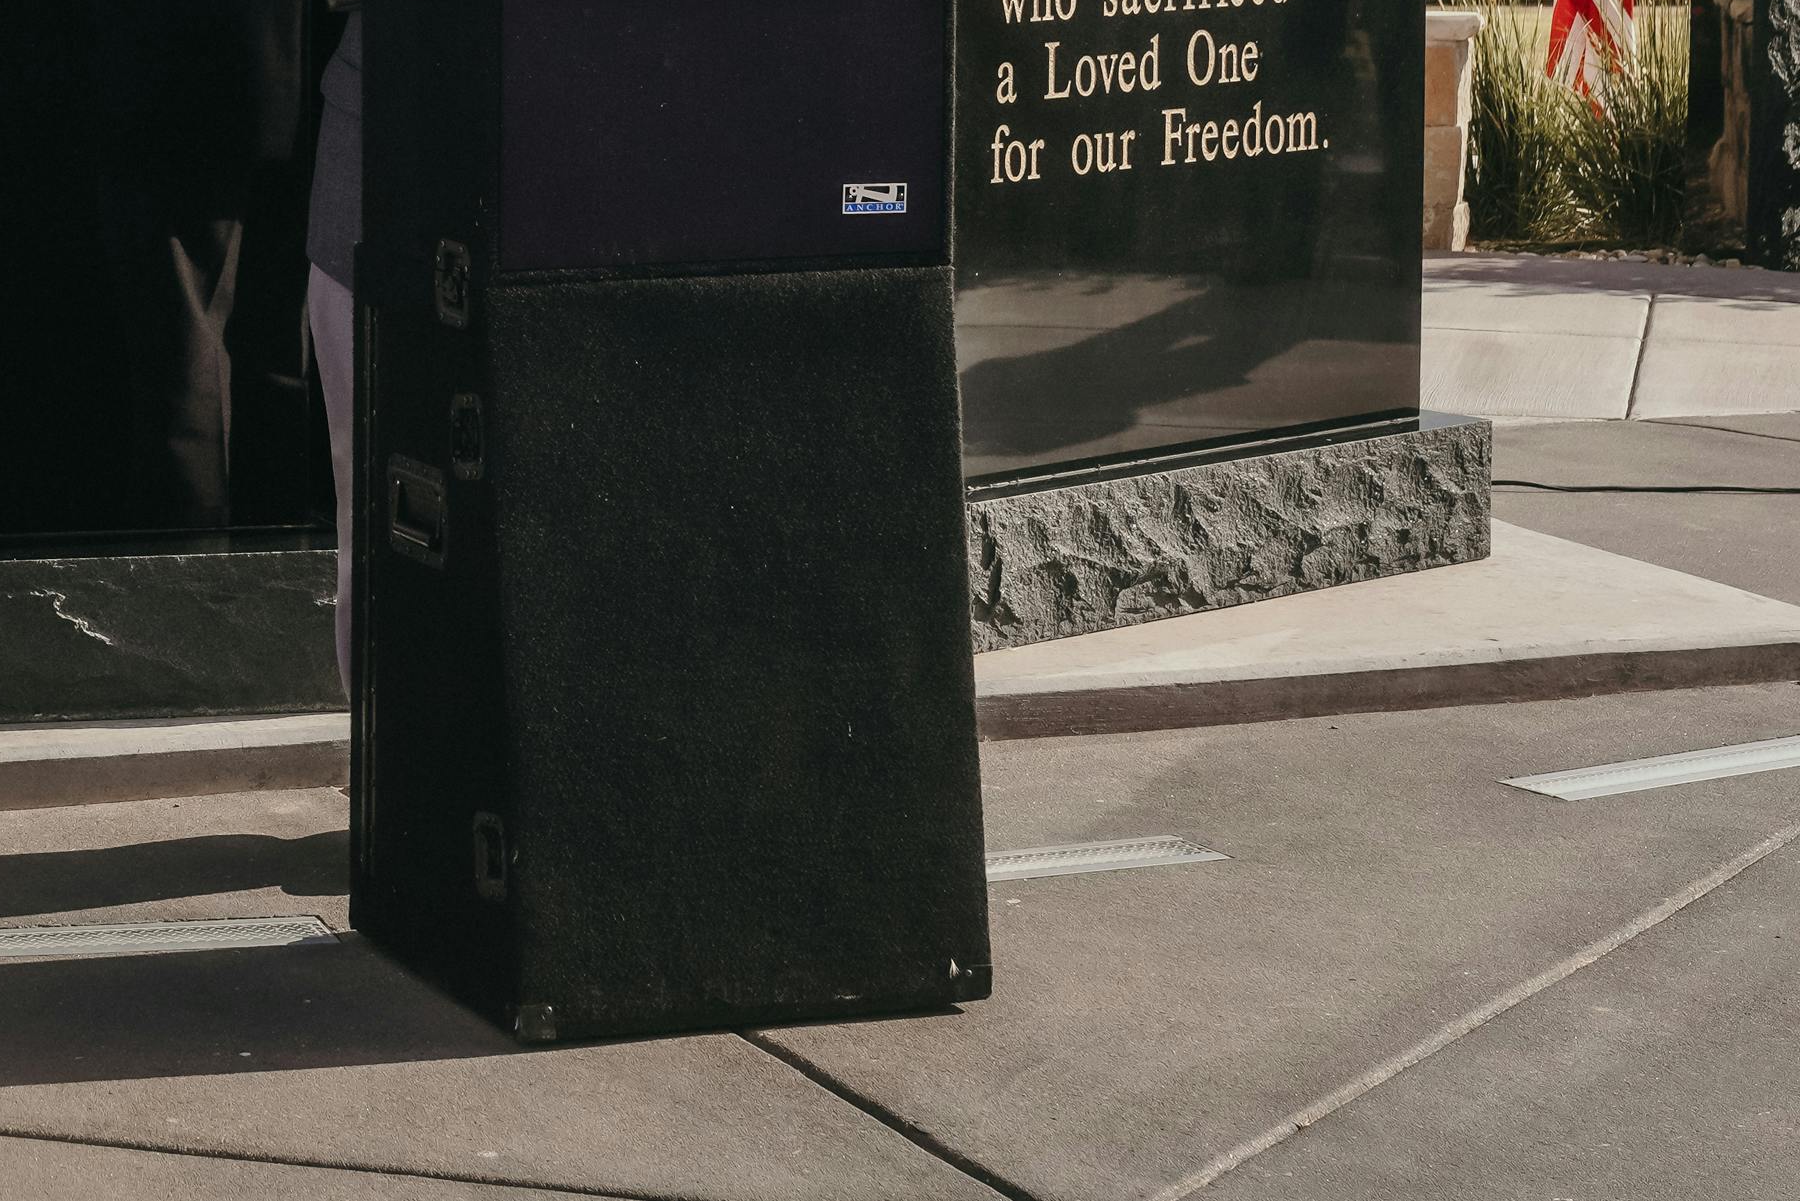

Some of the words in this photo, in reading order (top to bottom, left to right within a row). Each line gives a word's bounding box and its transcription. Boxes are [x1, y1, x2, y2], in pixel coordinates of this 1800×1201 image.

[997, 61, 1018, 104] a
[1044, 33, 1162, 101] Loved
[1187, 29, 1260, 87] One
[990, 125, 1046, 184] for
[1071, 128, 1136, 175] our
[1160, 100, 1330, 166] Freedom.
[846, 203, 902, 211] ANCHOR
